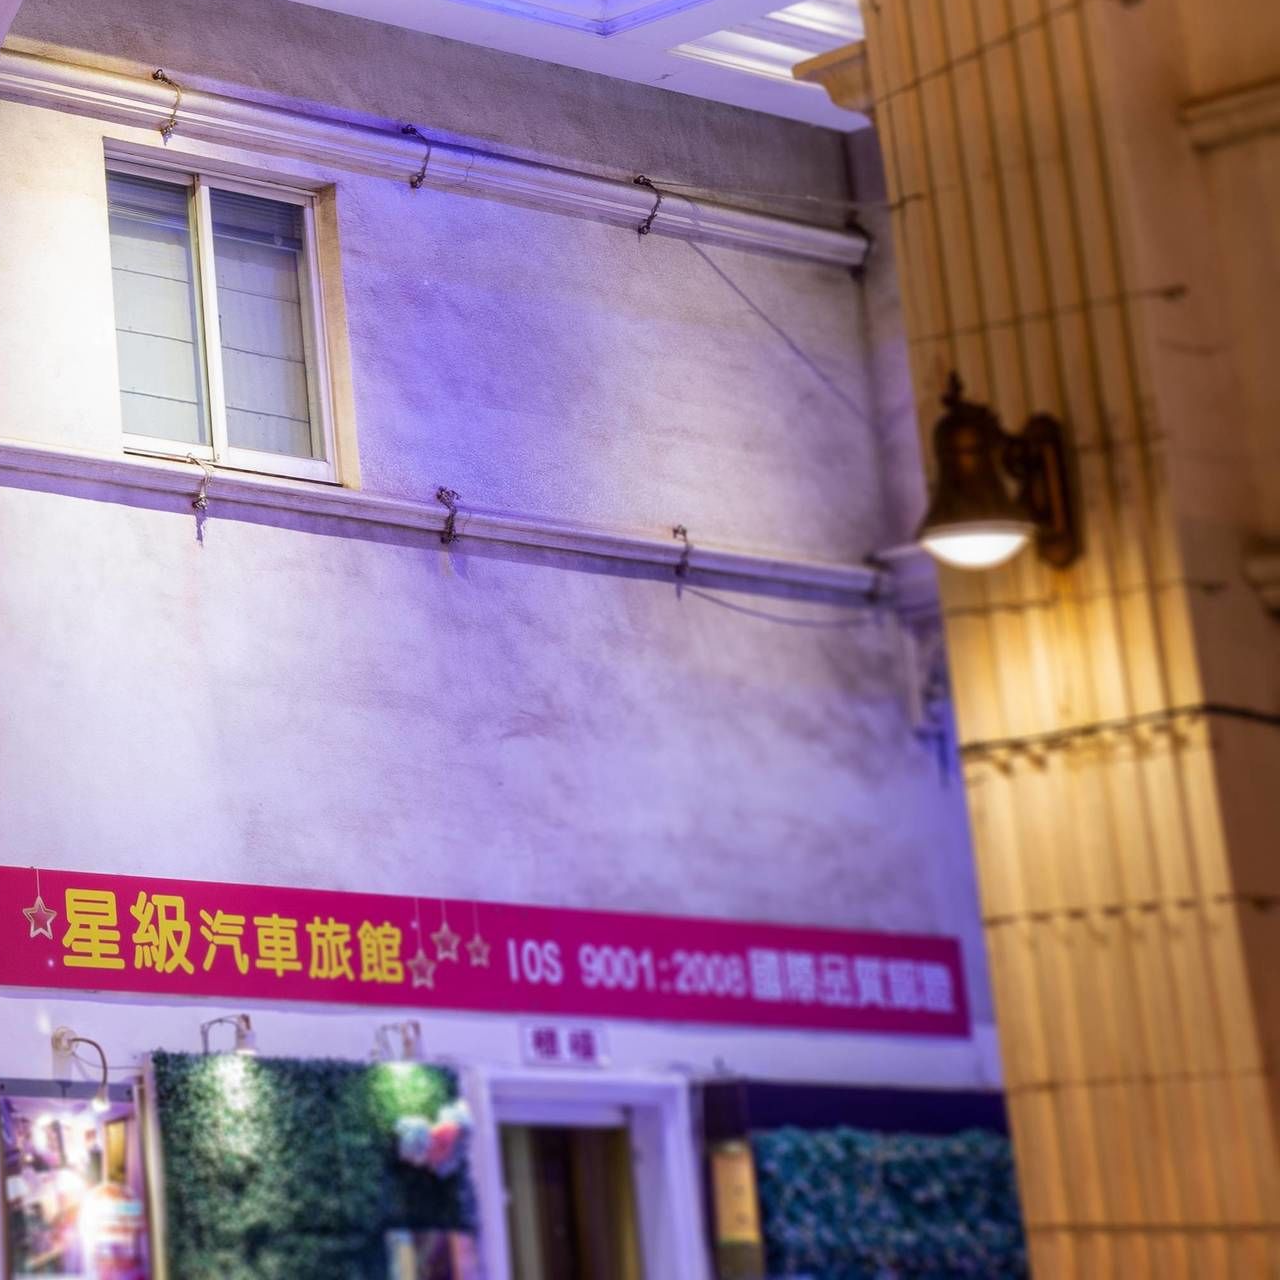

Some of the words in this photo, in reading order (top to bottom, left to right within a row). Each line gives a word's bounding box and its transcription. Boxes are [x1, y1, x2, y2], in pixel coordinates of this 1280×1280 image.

[62, 888, 405, 984] 星級汽車旅館
[507, 938, 564, 986] IOS
